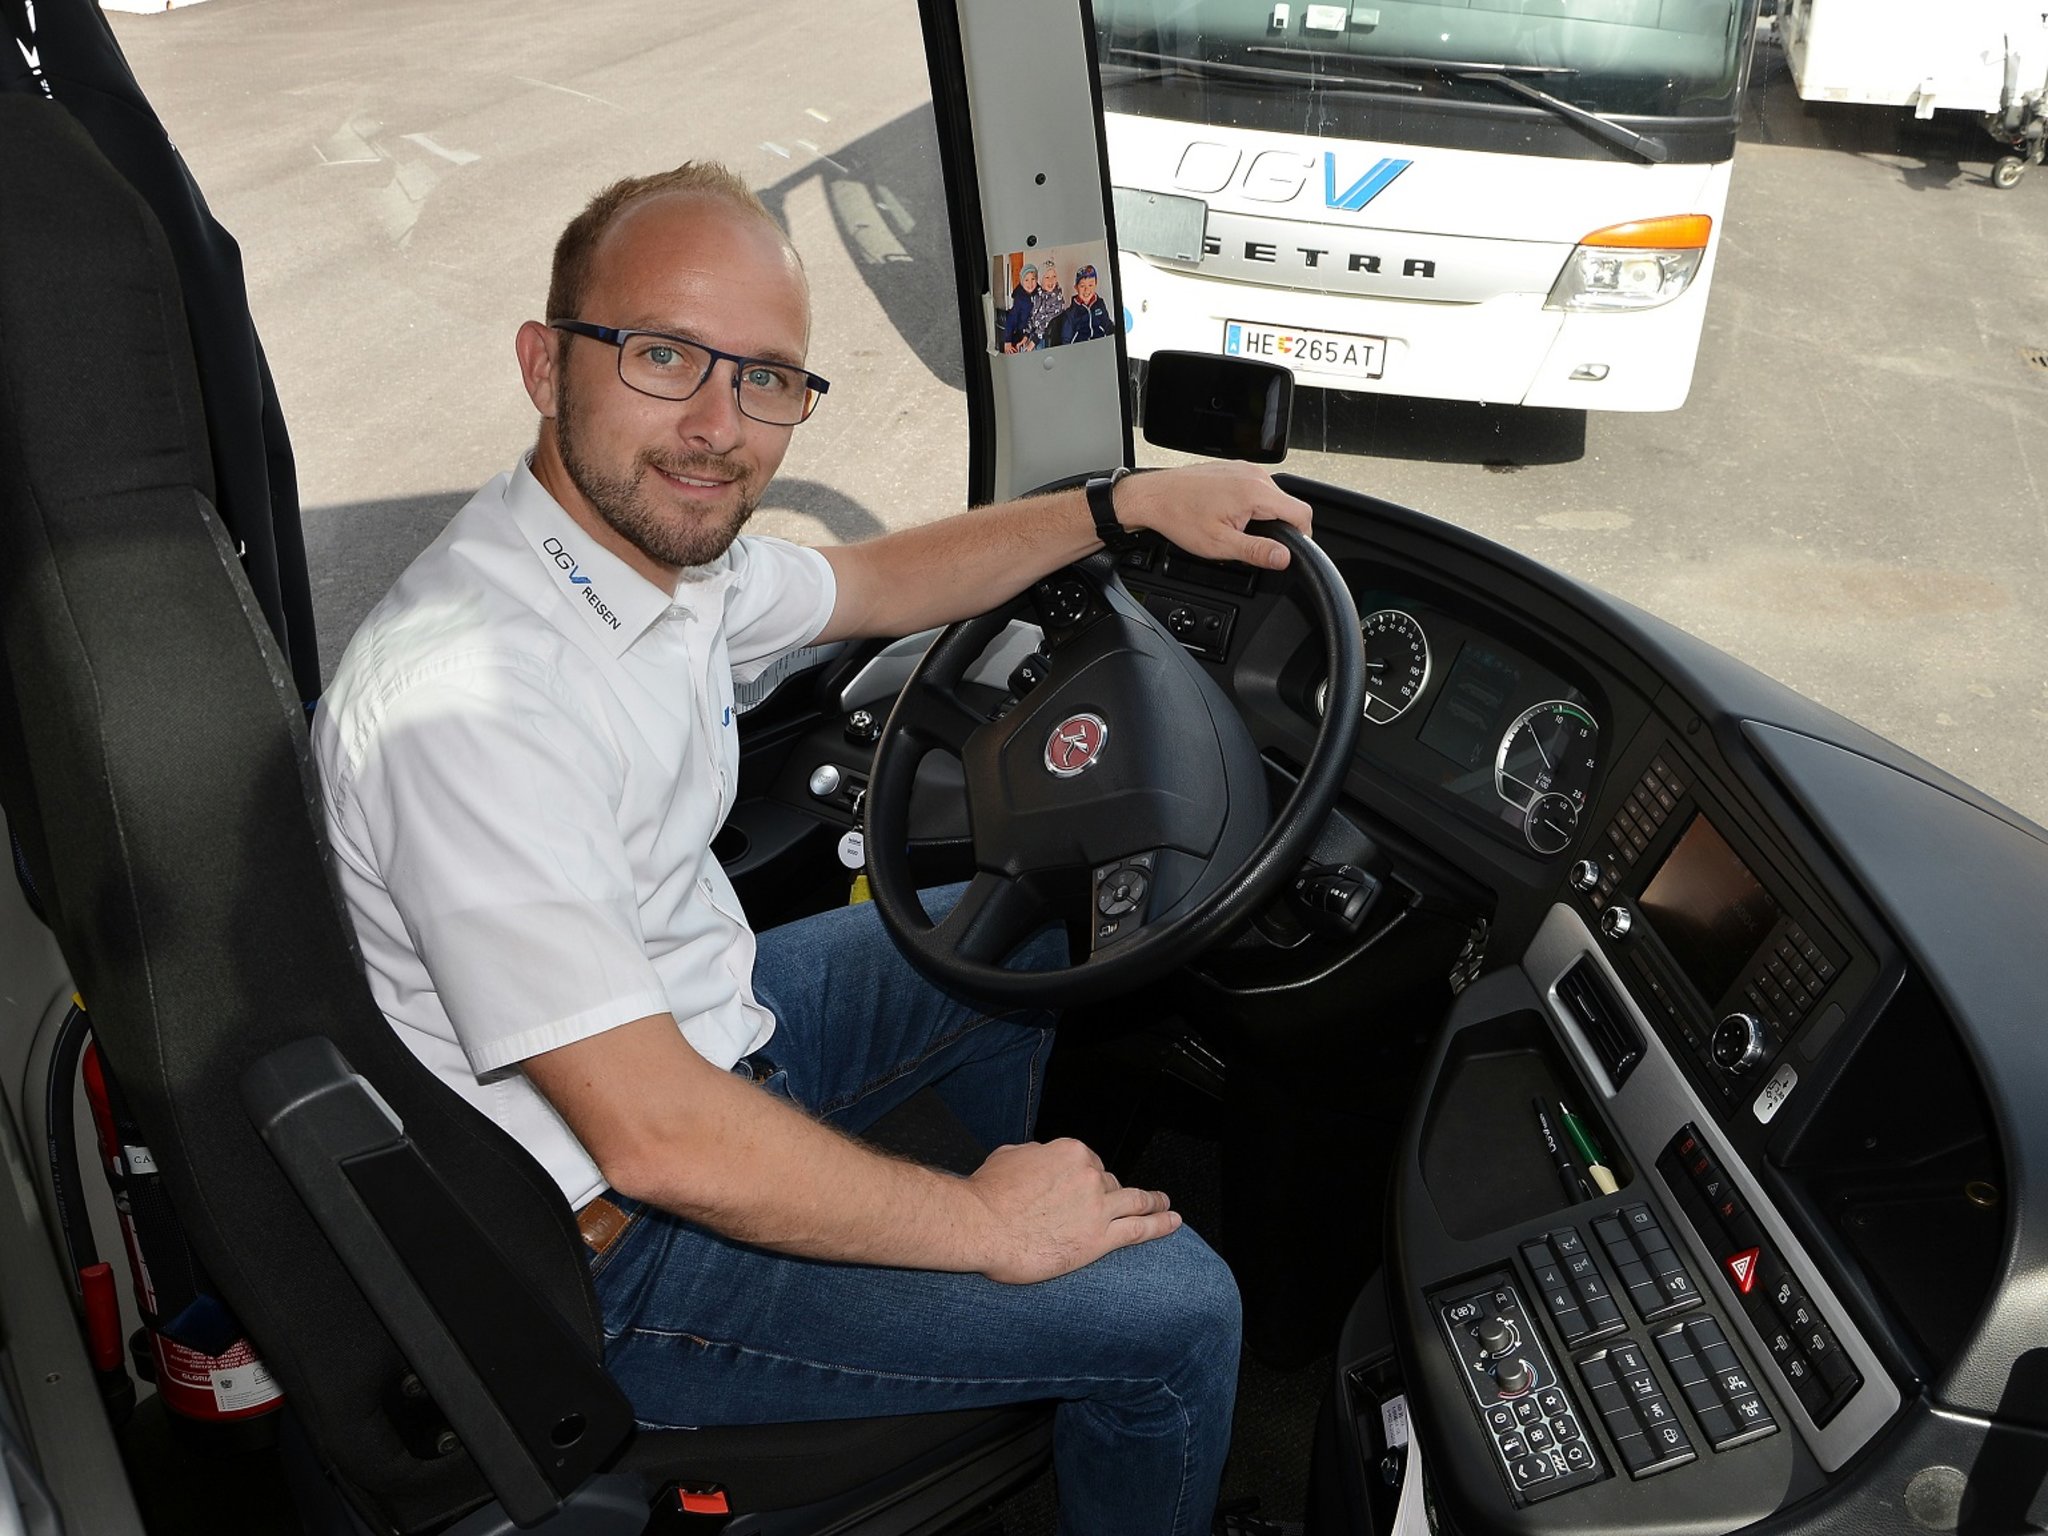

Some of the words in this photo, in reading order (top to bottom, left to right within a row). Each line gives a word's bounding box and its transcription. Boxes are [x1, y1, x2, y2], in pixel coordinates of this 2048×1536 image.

[1173, 140, 1414, 212] OGV
[1246, 331, 1276, 355] HE
[542, 537, 592, 584] OGV
[582, 586, 622, 630] REISEN
[1650, 1402, 1665, 1418] WC
